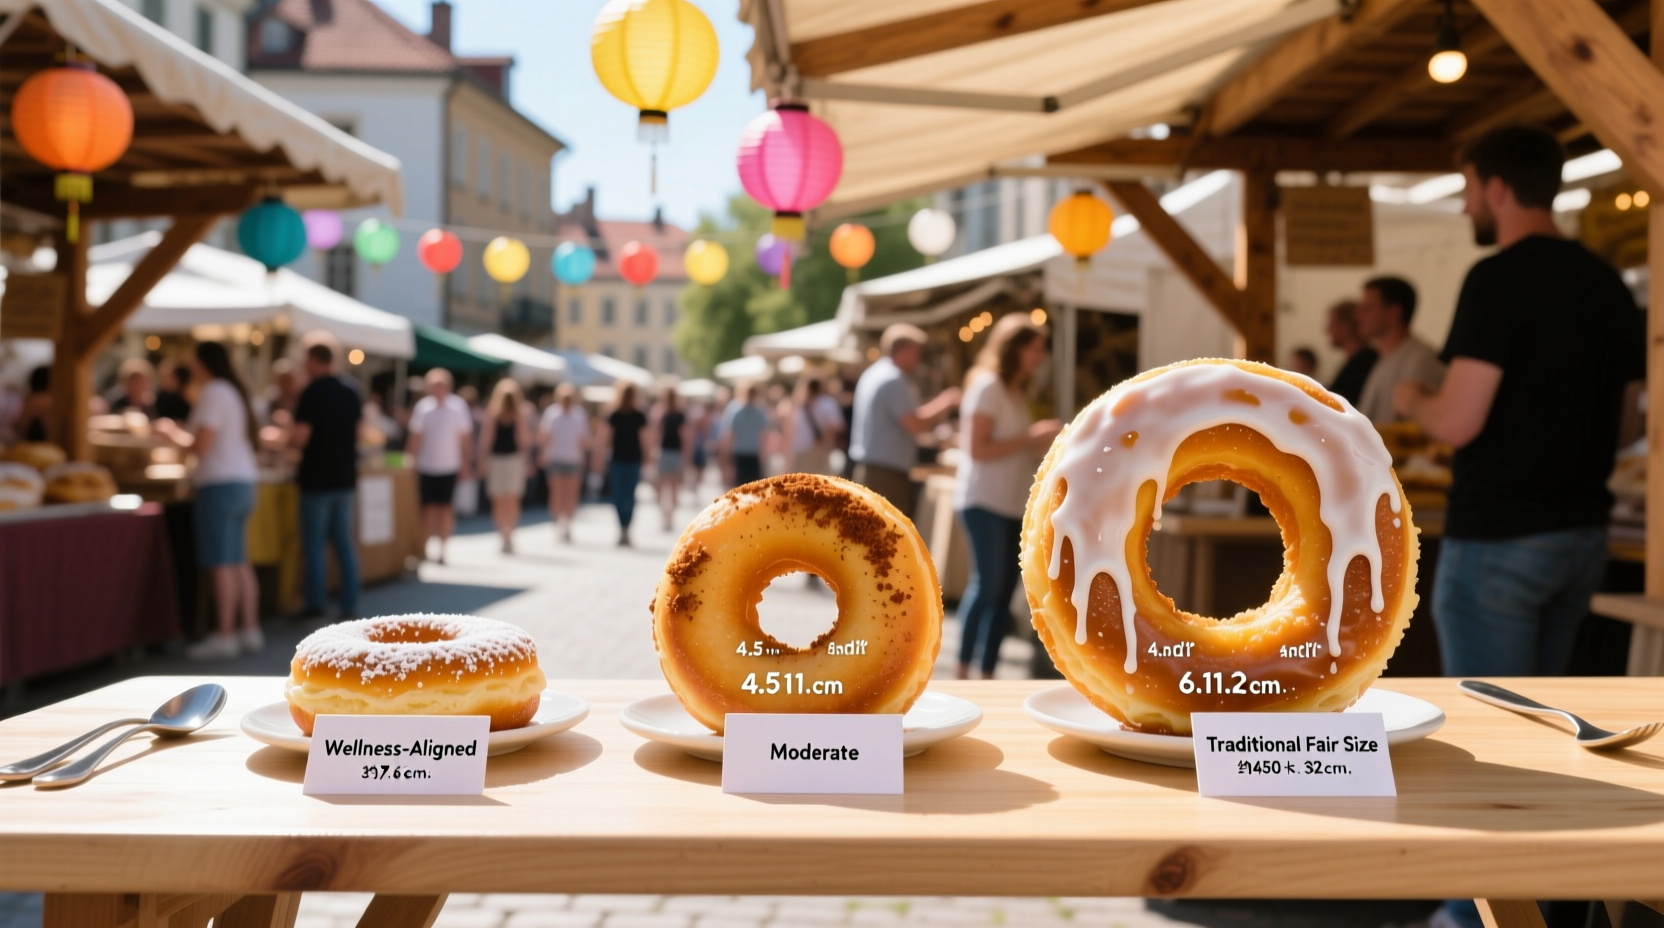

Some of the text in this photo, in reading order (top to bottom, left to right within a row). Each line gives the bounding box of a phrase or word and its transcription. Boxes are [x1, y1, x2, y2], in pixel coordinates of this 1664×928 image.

[325, 739, 477, 760] Wellness-Aligned
[771, 743, 859, 760] Moderate
[1206, 736, 1378, 752] Traditional Fair Size
